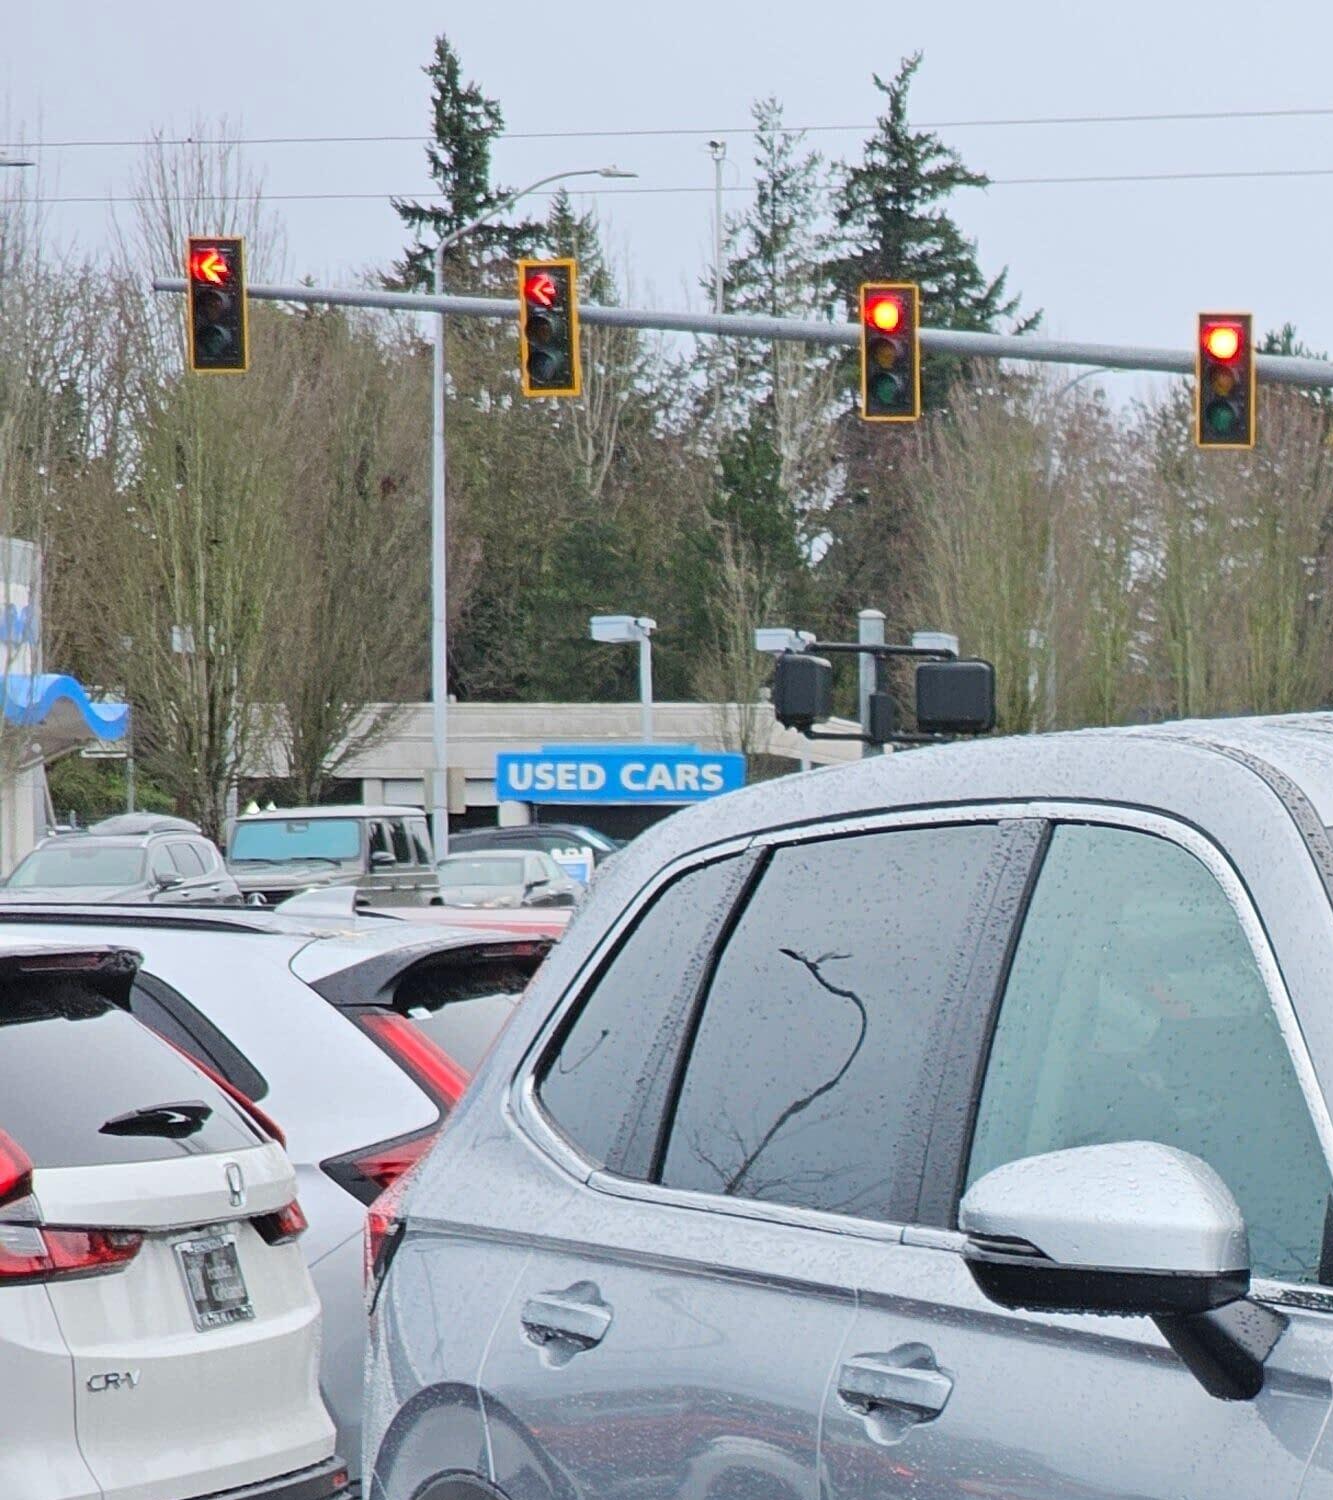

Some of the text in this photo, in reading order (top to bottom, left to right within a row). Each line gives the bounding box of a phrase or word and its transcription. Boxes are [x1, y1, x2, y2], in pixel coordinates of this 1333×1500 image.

[508, 763, 724, 792] USED CARS
[86, 1369, 141, 1392] CR-V
